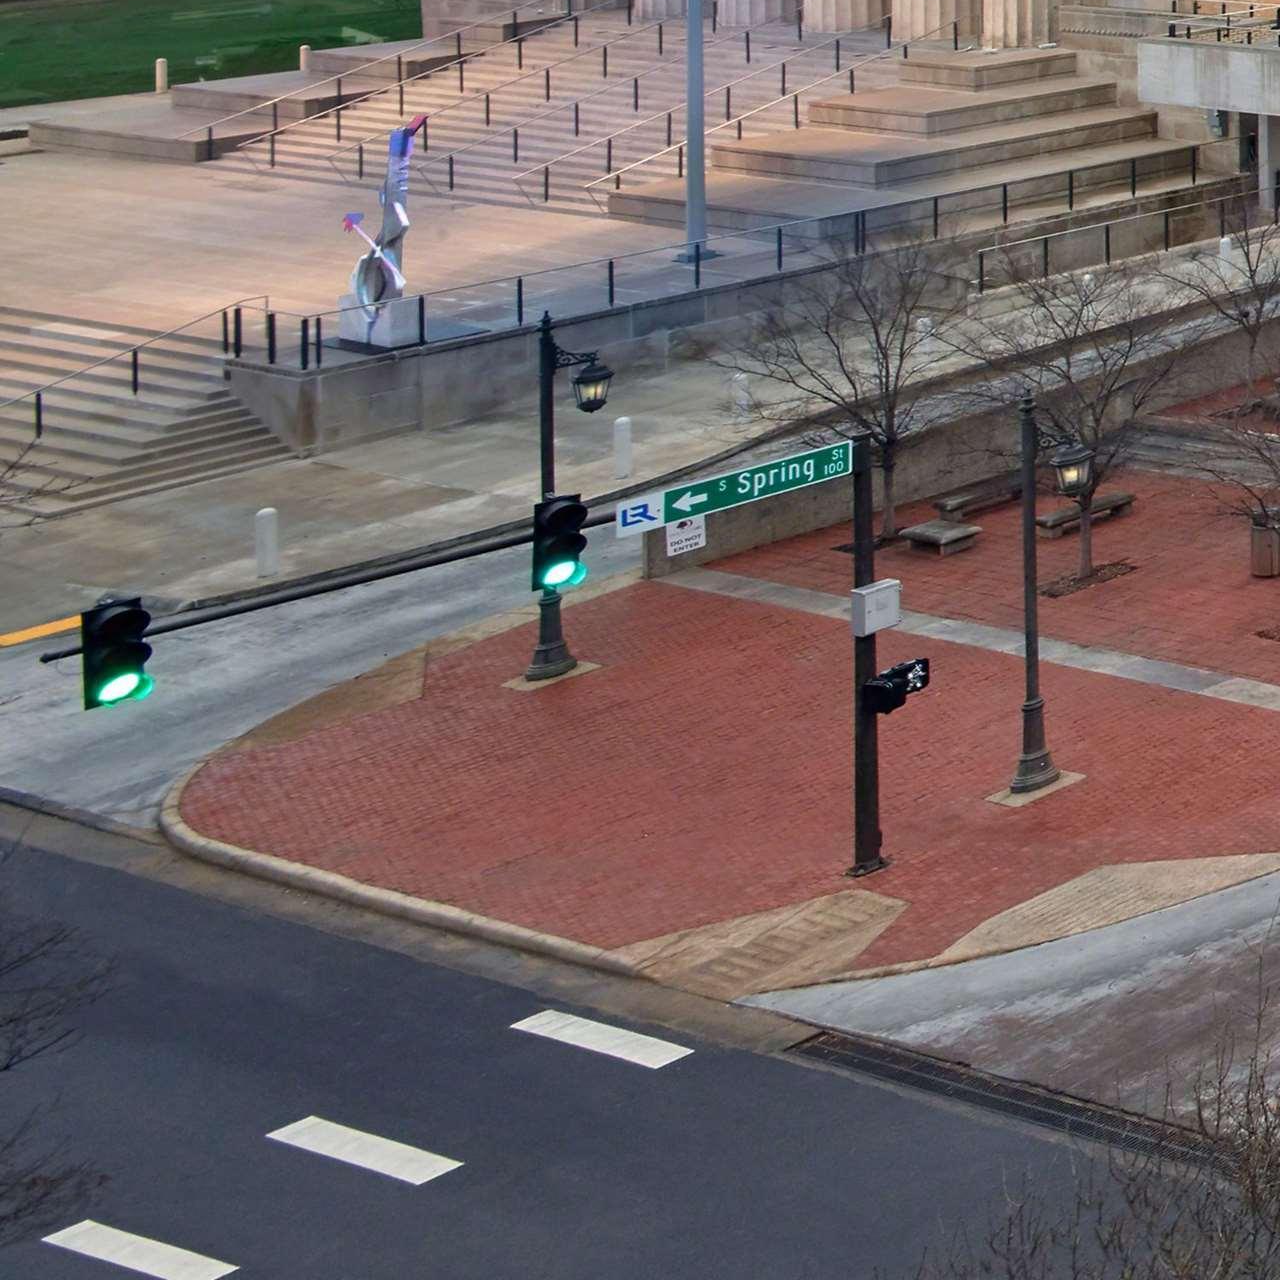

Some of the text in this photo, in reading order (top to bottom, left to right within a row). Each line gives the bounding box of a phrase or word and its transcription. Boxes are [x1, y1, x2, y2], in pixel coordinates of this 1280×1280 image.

[718, 447, 844, 496] S Spring St
[824, 461, 844, 475] 100
[670, 533, 702, 548] DO NOT
[673, 541, 700, 553] ENTER
